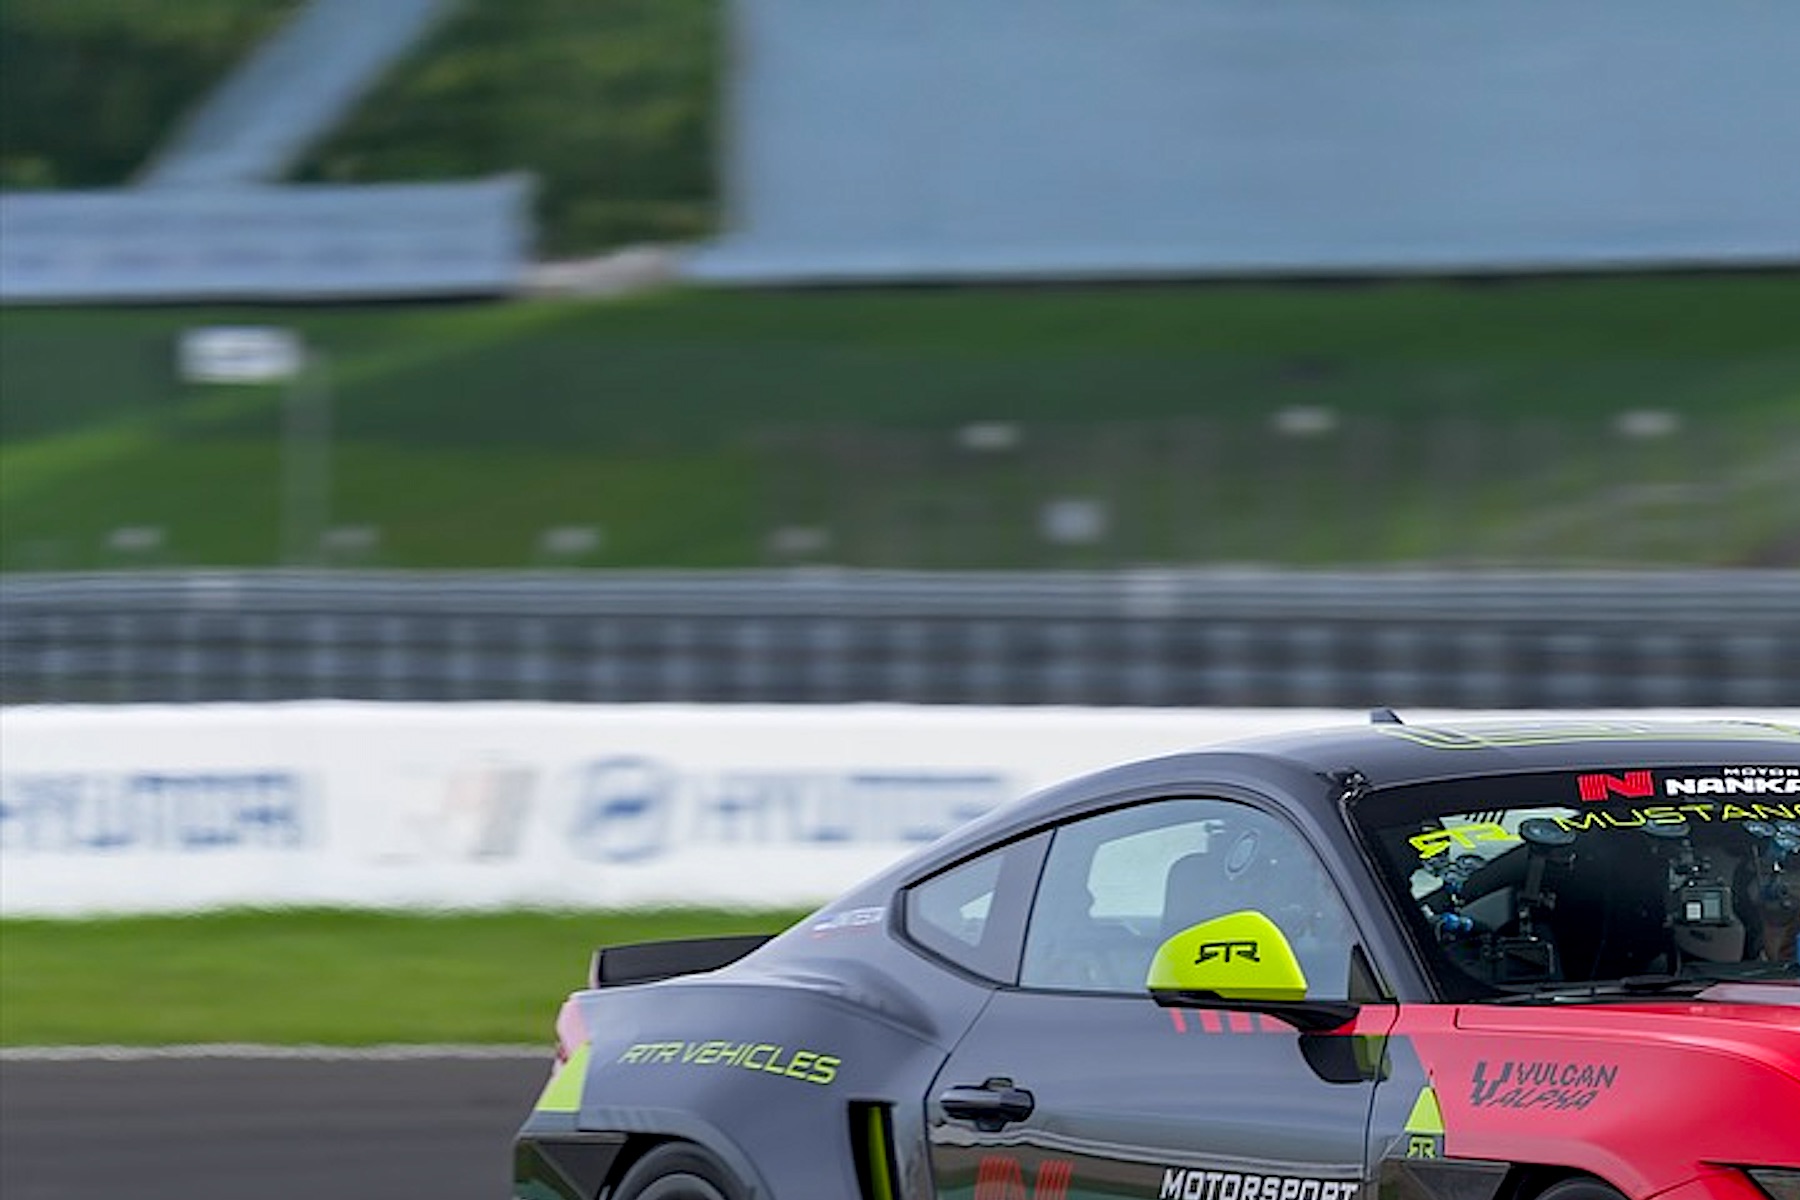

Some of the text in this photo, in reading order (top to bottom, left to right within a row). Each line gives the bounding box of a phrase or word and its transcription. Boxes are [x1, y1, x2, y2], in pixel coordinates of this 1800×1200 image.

[617, 1040, 842, 1085] RTR VEHICLES
[1516, 1062, 1618, 1088] VULCAN
[1487, 1087, 1599, 1110] ALPHA
